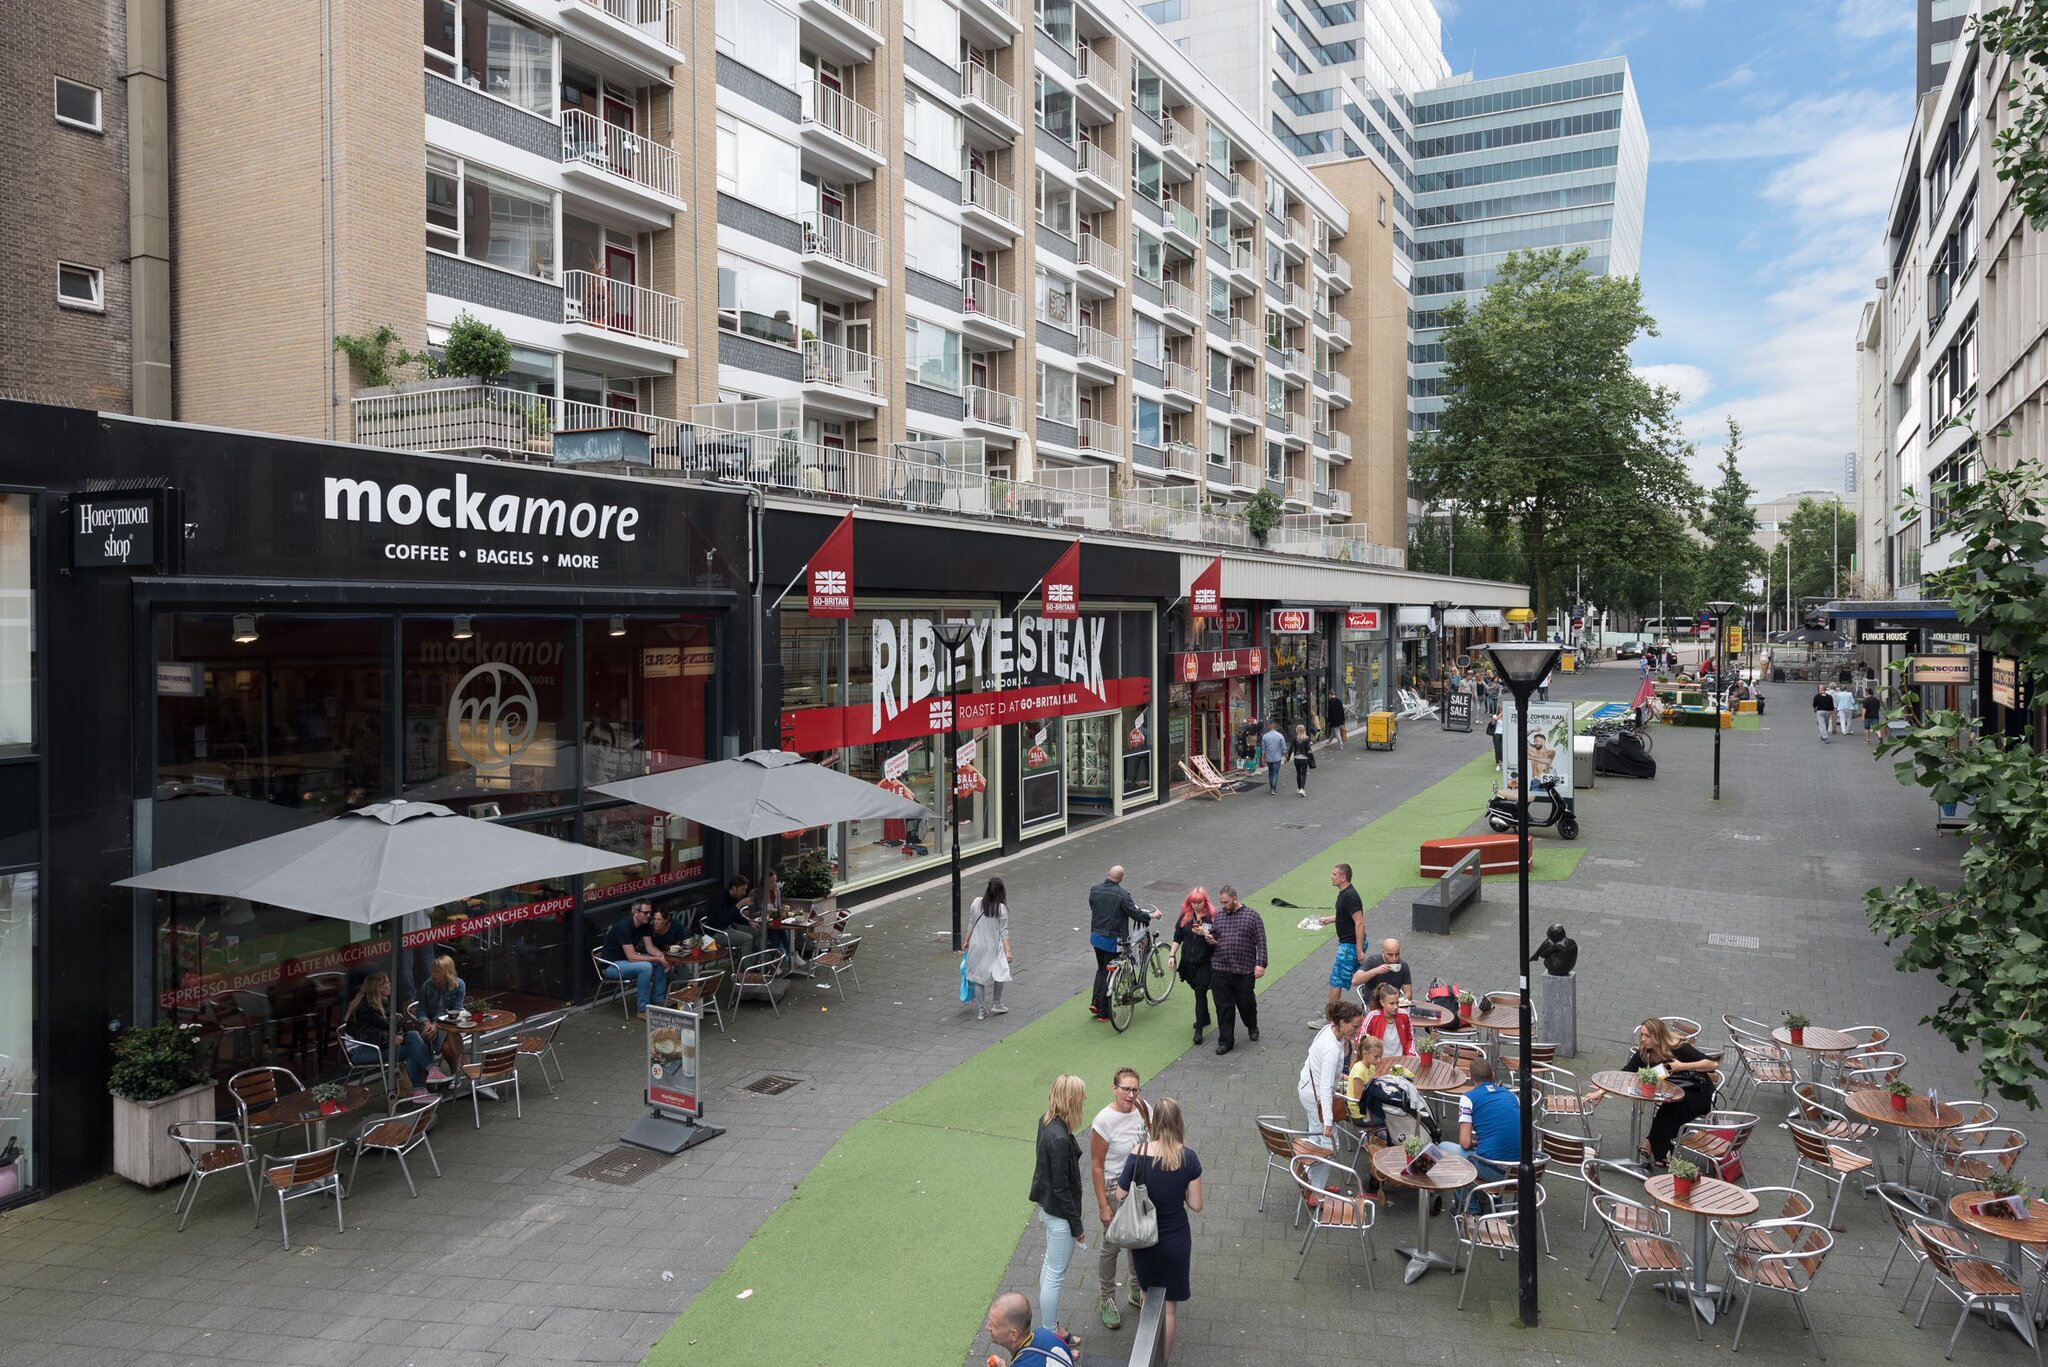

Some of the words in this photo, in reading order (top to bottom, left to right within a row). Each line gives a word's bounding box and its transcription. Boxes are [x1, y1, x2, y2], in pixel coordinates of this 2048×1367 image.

[80, 504, 149, 533] Honeymoon
[324, 473, 639, 542] mockamore
[385, 544, 449, 561] COFFEE
[477, 549, 534, 566] BAGELS
[558, 554, 599, 568] MORE
[813, 597, 849, 606] GO-BRITAIN
[1862, 632, 1884, 641] FUNKIE
[1212, 652, 1225, 678] daily
[1226, 650, 1237, 670] rush
[1009, 700, 1020, 712] AT
[1450, 695, 1468, 705] SALE
[1450, 706, 1468, 716] SALE
[957, 773, 977, 784] SALE
[607, 876, 656, 896] CHEESECAKE
[660, 873, 673, 885] TEA
[676, 865, 702, 880] COFFEE
[402, 925, 456, 948] BROWNIE
[461, 906, 528, 933] SANDWICHES
[534, 898, 573, 916] CAPPUC
[160, 980, 227, 1006] ESPRESSO
[234, 966, 281, 989] BAGELS
[287, 958, 321, 977] LATTE
[324, 941, 392, 966] MACCHIATO
